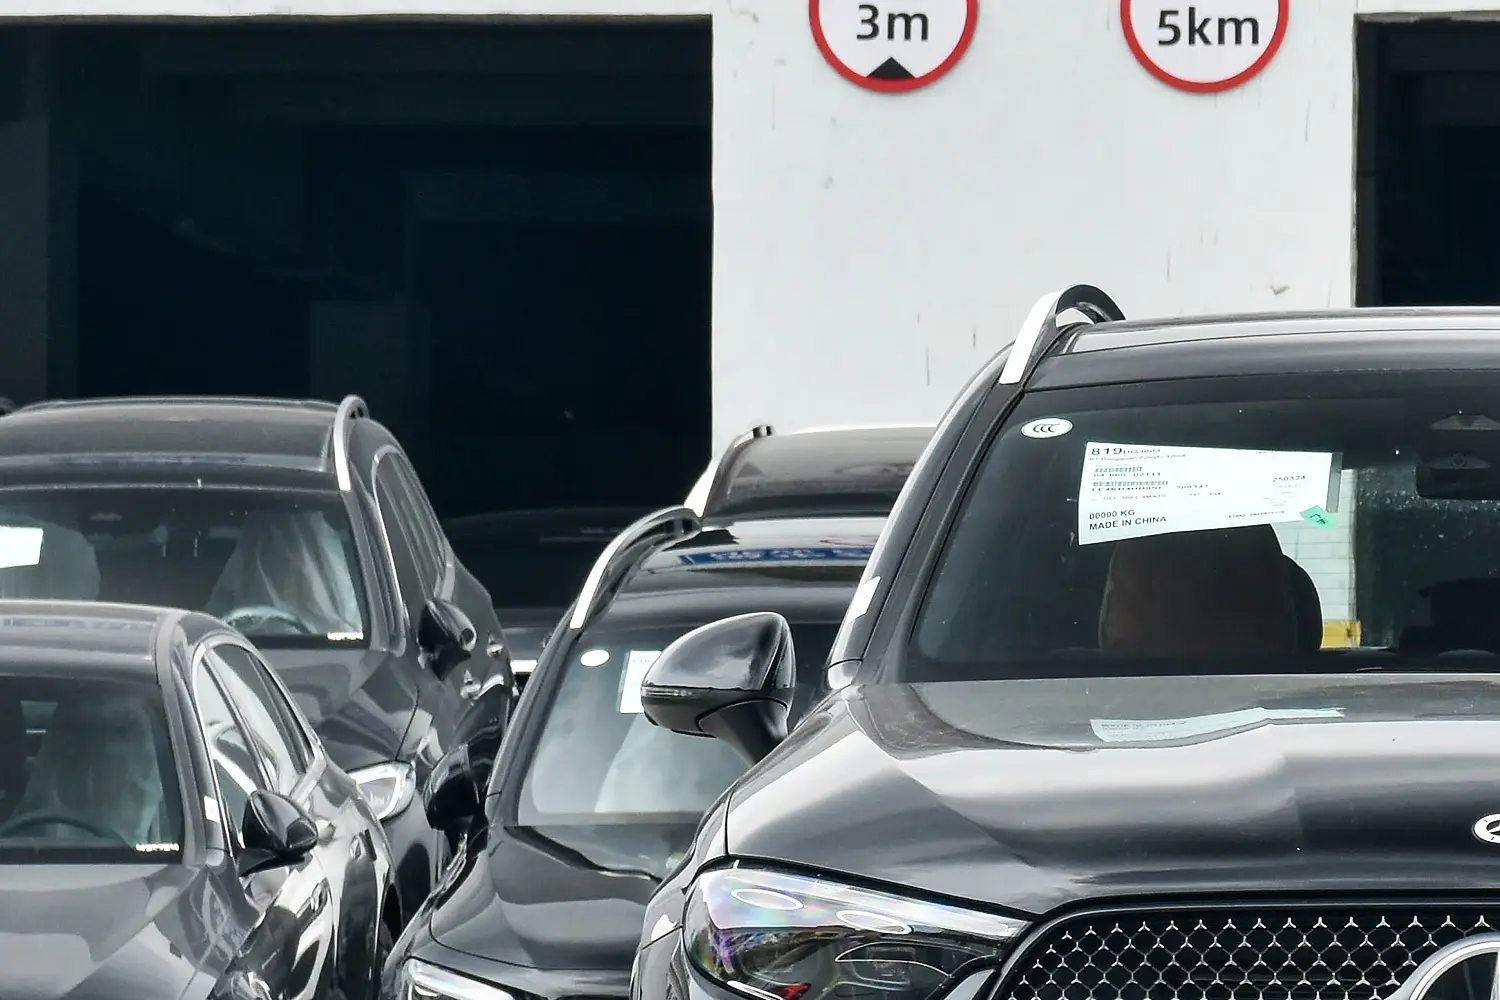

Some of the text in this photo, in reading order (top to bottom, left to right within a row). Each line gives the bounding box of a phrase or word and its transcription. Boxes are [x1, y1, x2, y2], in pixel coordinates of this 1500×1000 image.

[856, 4, 929, 41] 3m
[1157, 7, 1260, 47] 5km
[1089, 516, 1167, 530] MADE IN CHINA
[1120, 509, 1135, 517] KG
